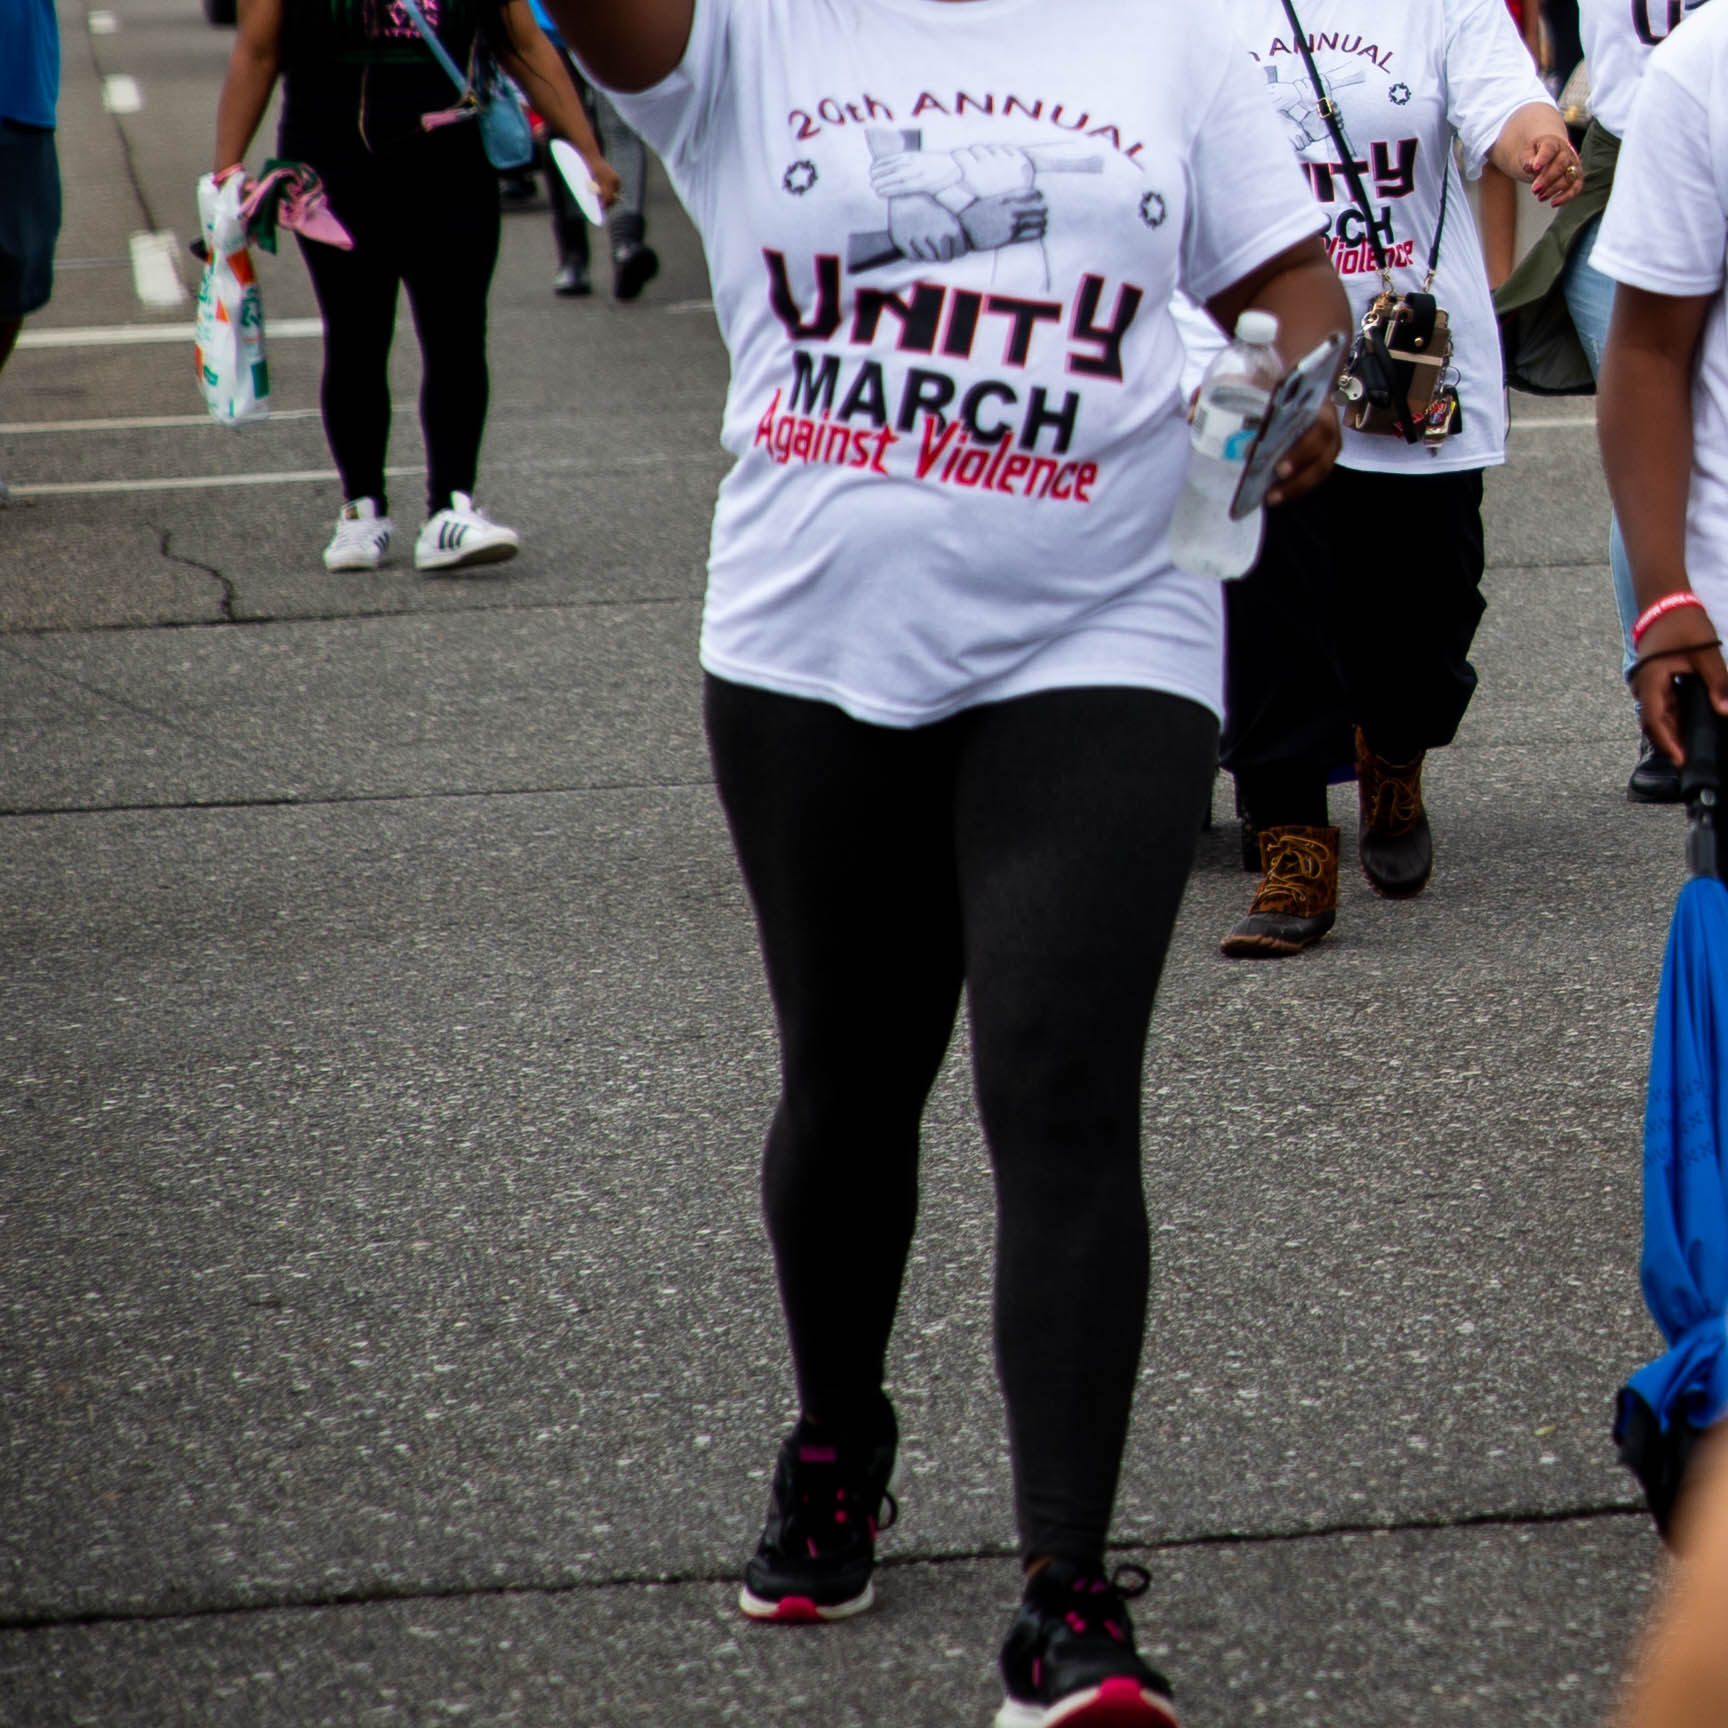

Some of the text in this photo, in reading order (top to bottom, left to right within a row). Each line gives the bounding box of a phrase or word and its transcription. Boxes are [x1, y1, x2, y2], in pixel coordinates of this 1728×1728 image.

[788, 90, 1148, 171] 20th ANNUAL
[761, 248, 1144, 384] UNITY
[754, 388, 1100, 504] Against Violence
[788, 350, 1081, 457] MARCH
